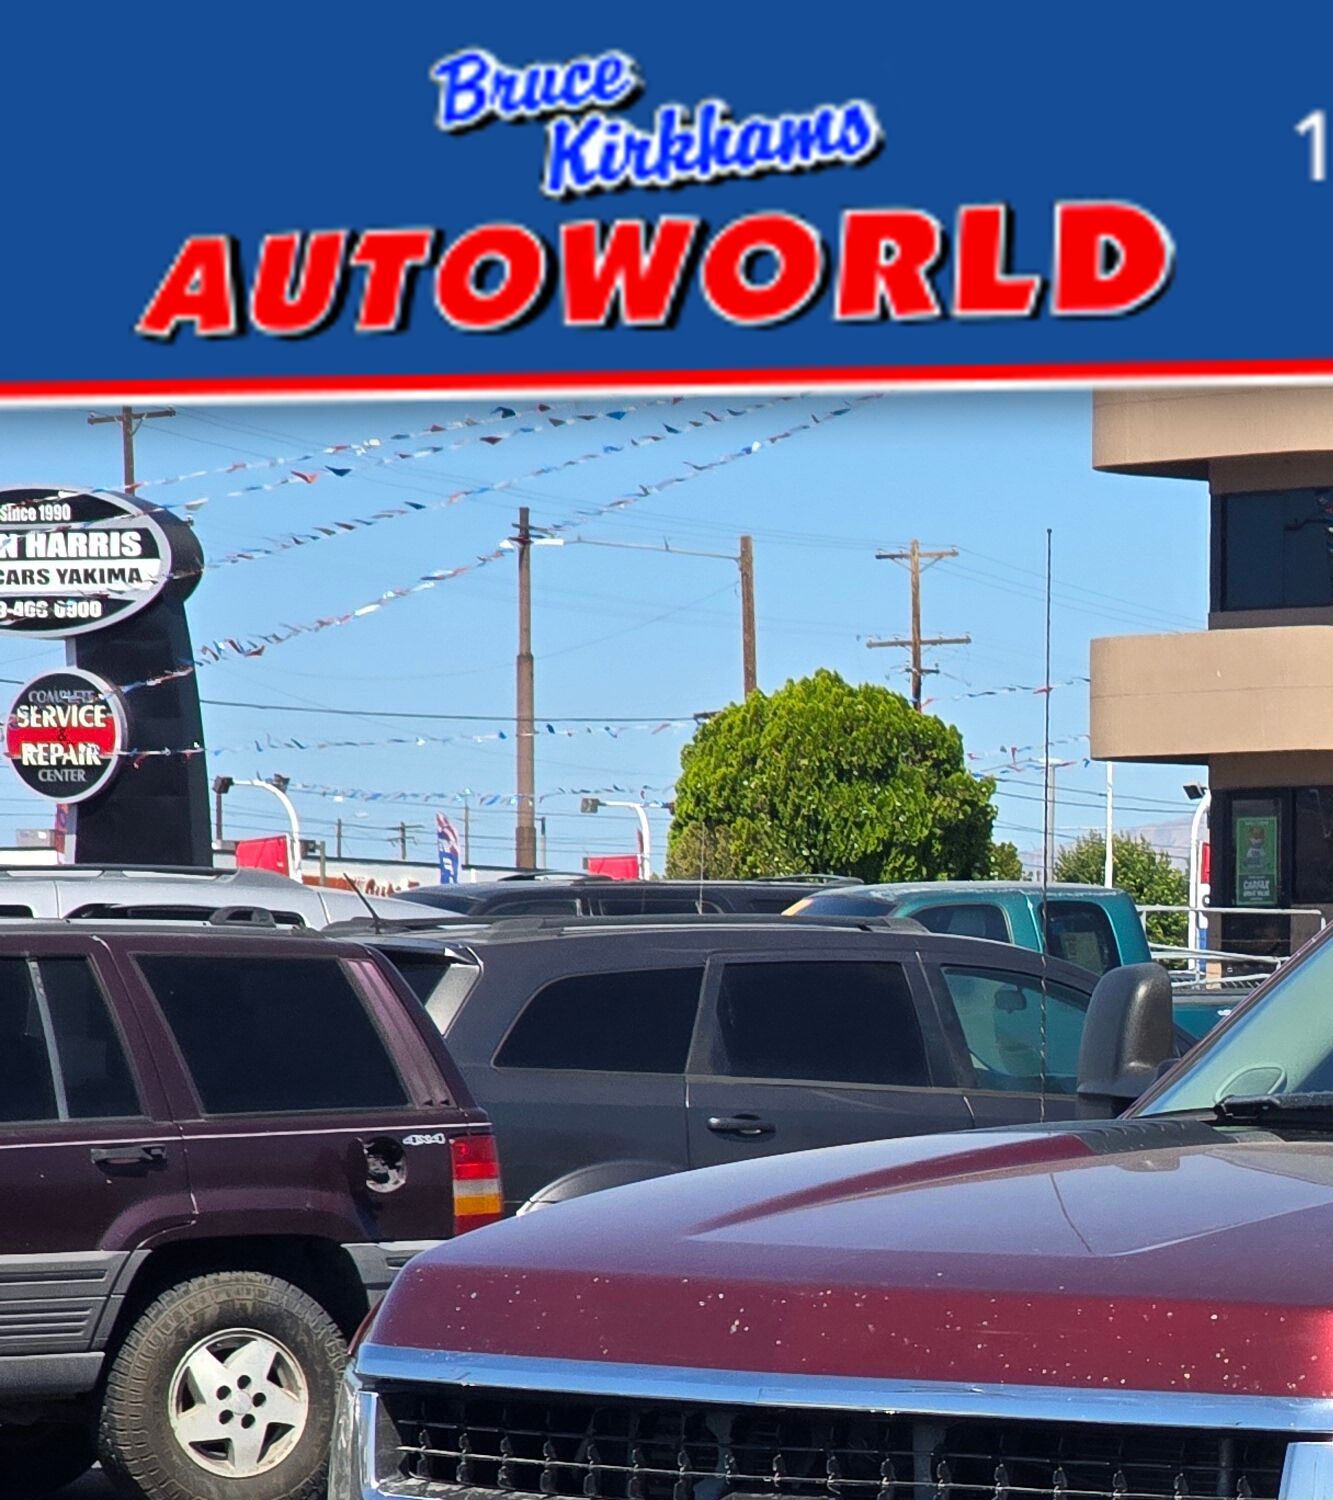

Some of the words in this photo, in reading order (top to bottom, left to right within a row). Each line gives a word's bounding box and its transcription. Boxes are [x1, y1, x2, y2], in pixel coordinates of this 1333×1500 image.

[39, 502, 72, 522] 1990
[25, 530, 142, 558] HARRIS
[56, 567, 143, 585] YAKIMA
[16, 704, 107, 728] SERVICE
[21, 742, 101, 766] REPAIR
[37, 768, 86, 782] CENTER
